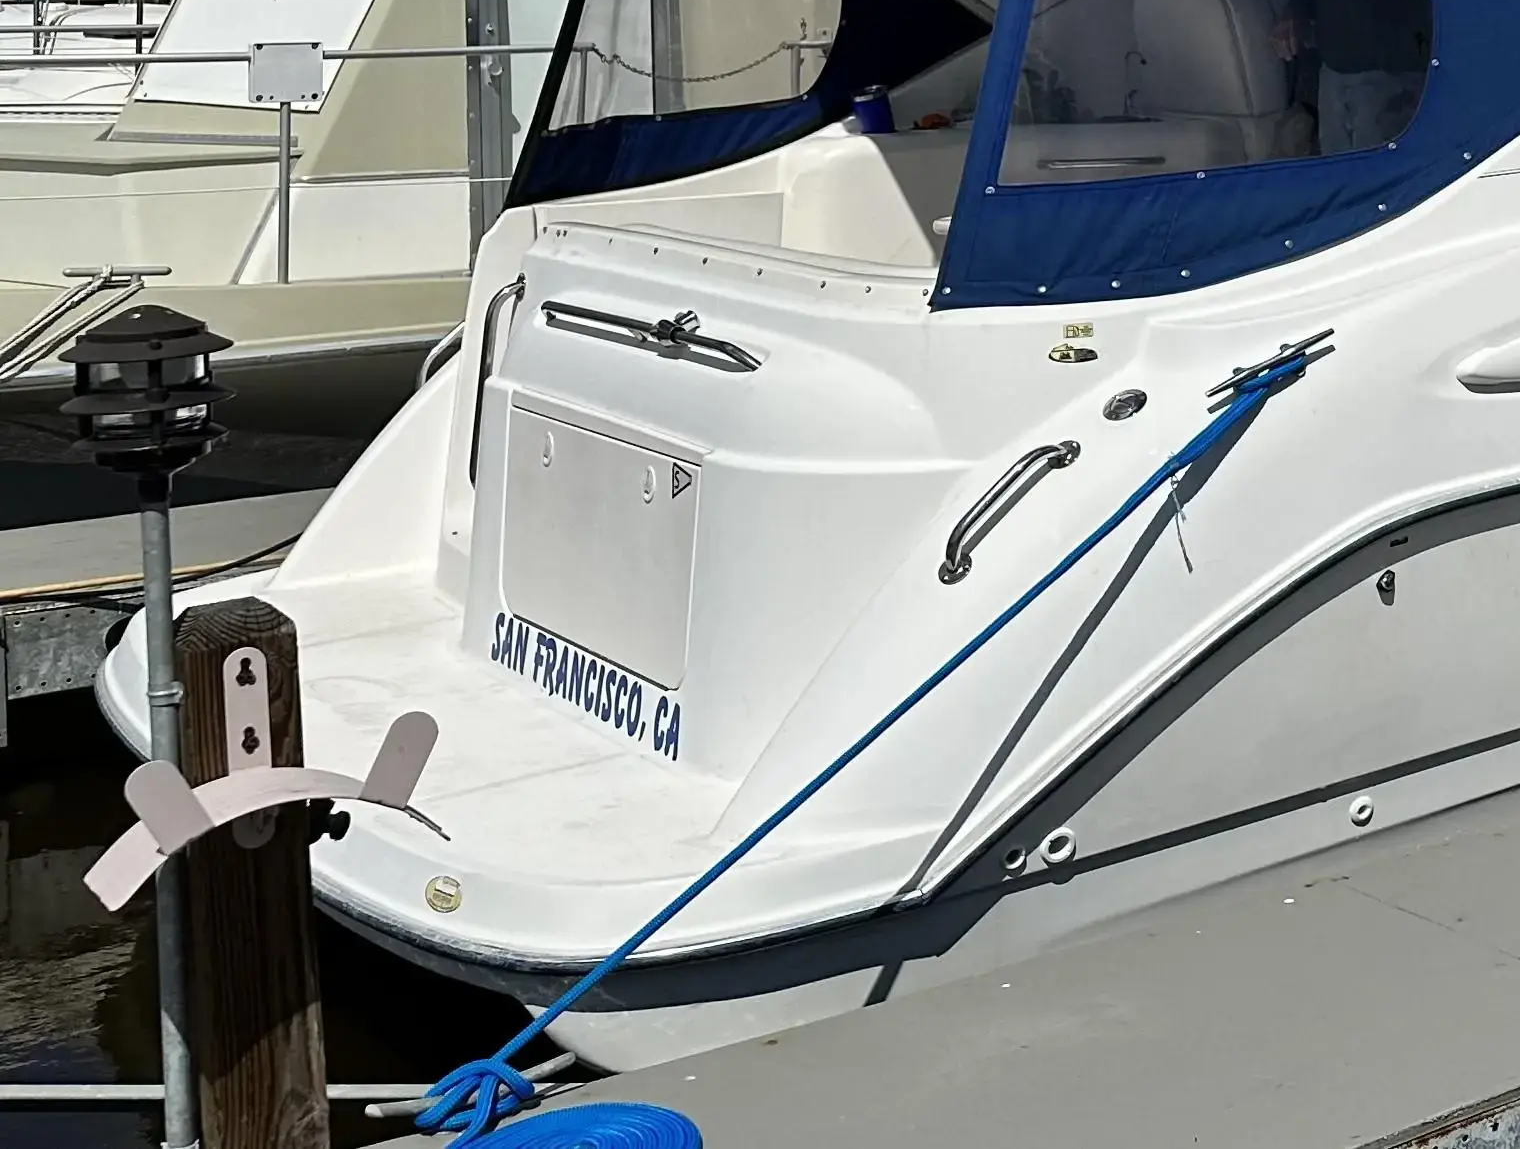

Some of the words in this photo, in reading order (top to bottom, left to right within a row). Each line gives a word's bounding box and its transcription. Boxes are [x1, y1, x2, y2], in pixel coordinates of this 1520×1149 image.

[491, 612, 530, 676] SAN
[532, 632, 646, 742] FRANCISCO,
[653, 695, 681, 761] CA
